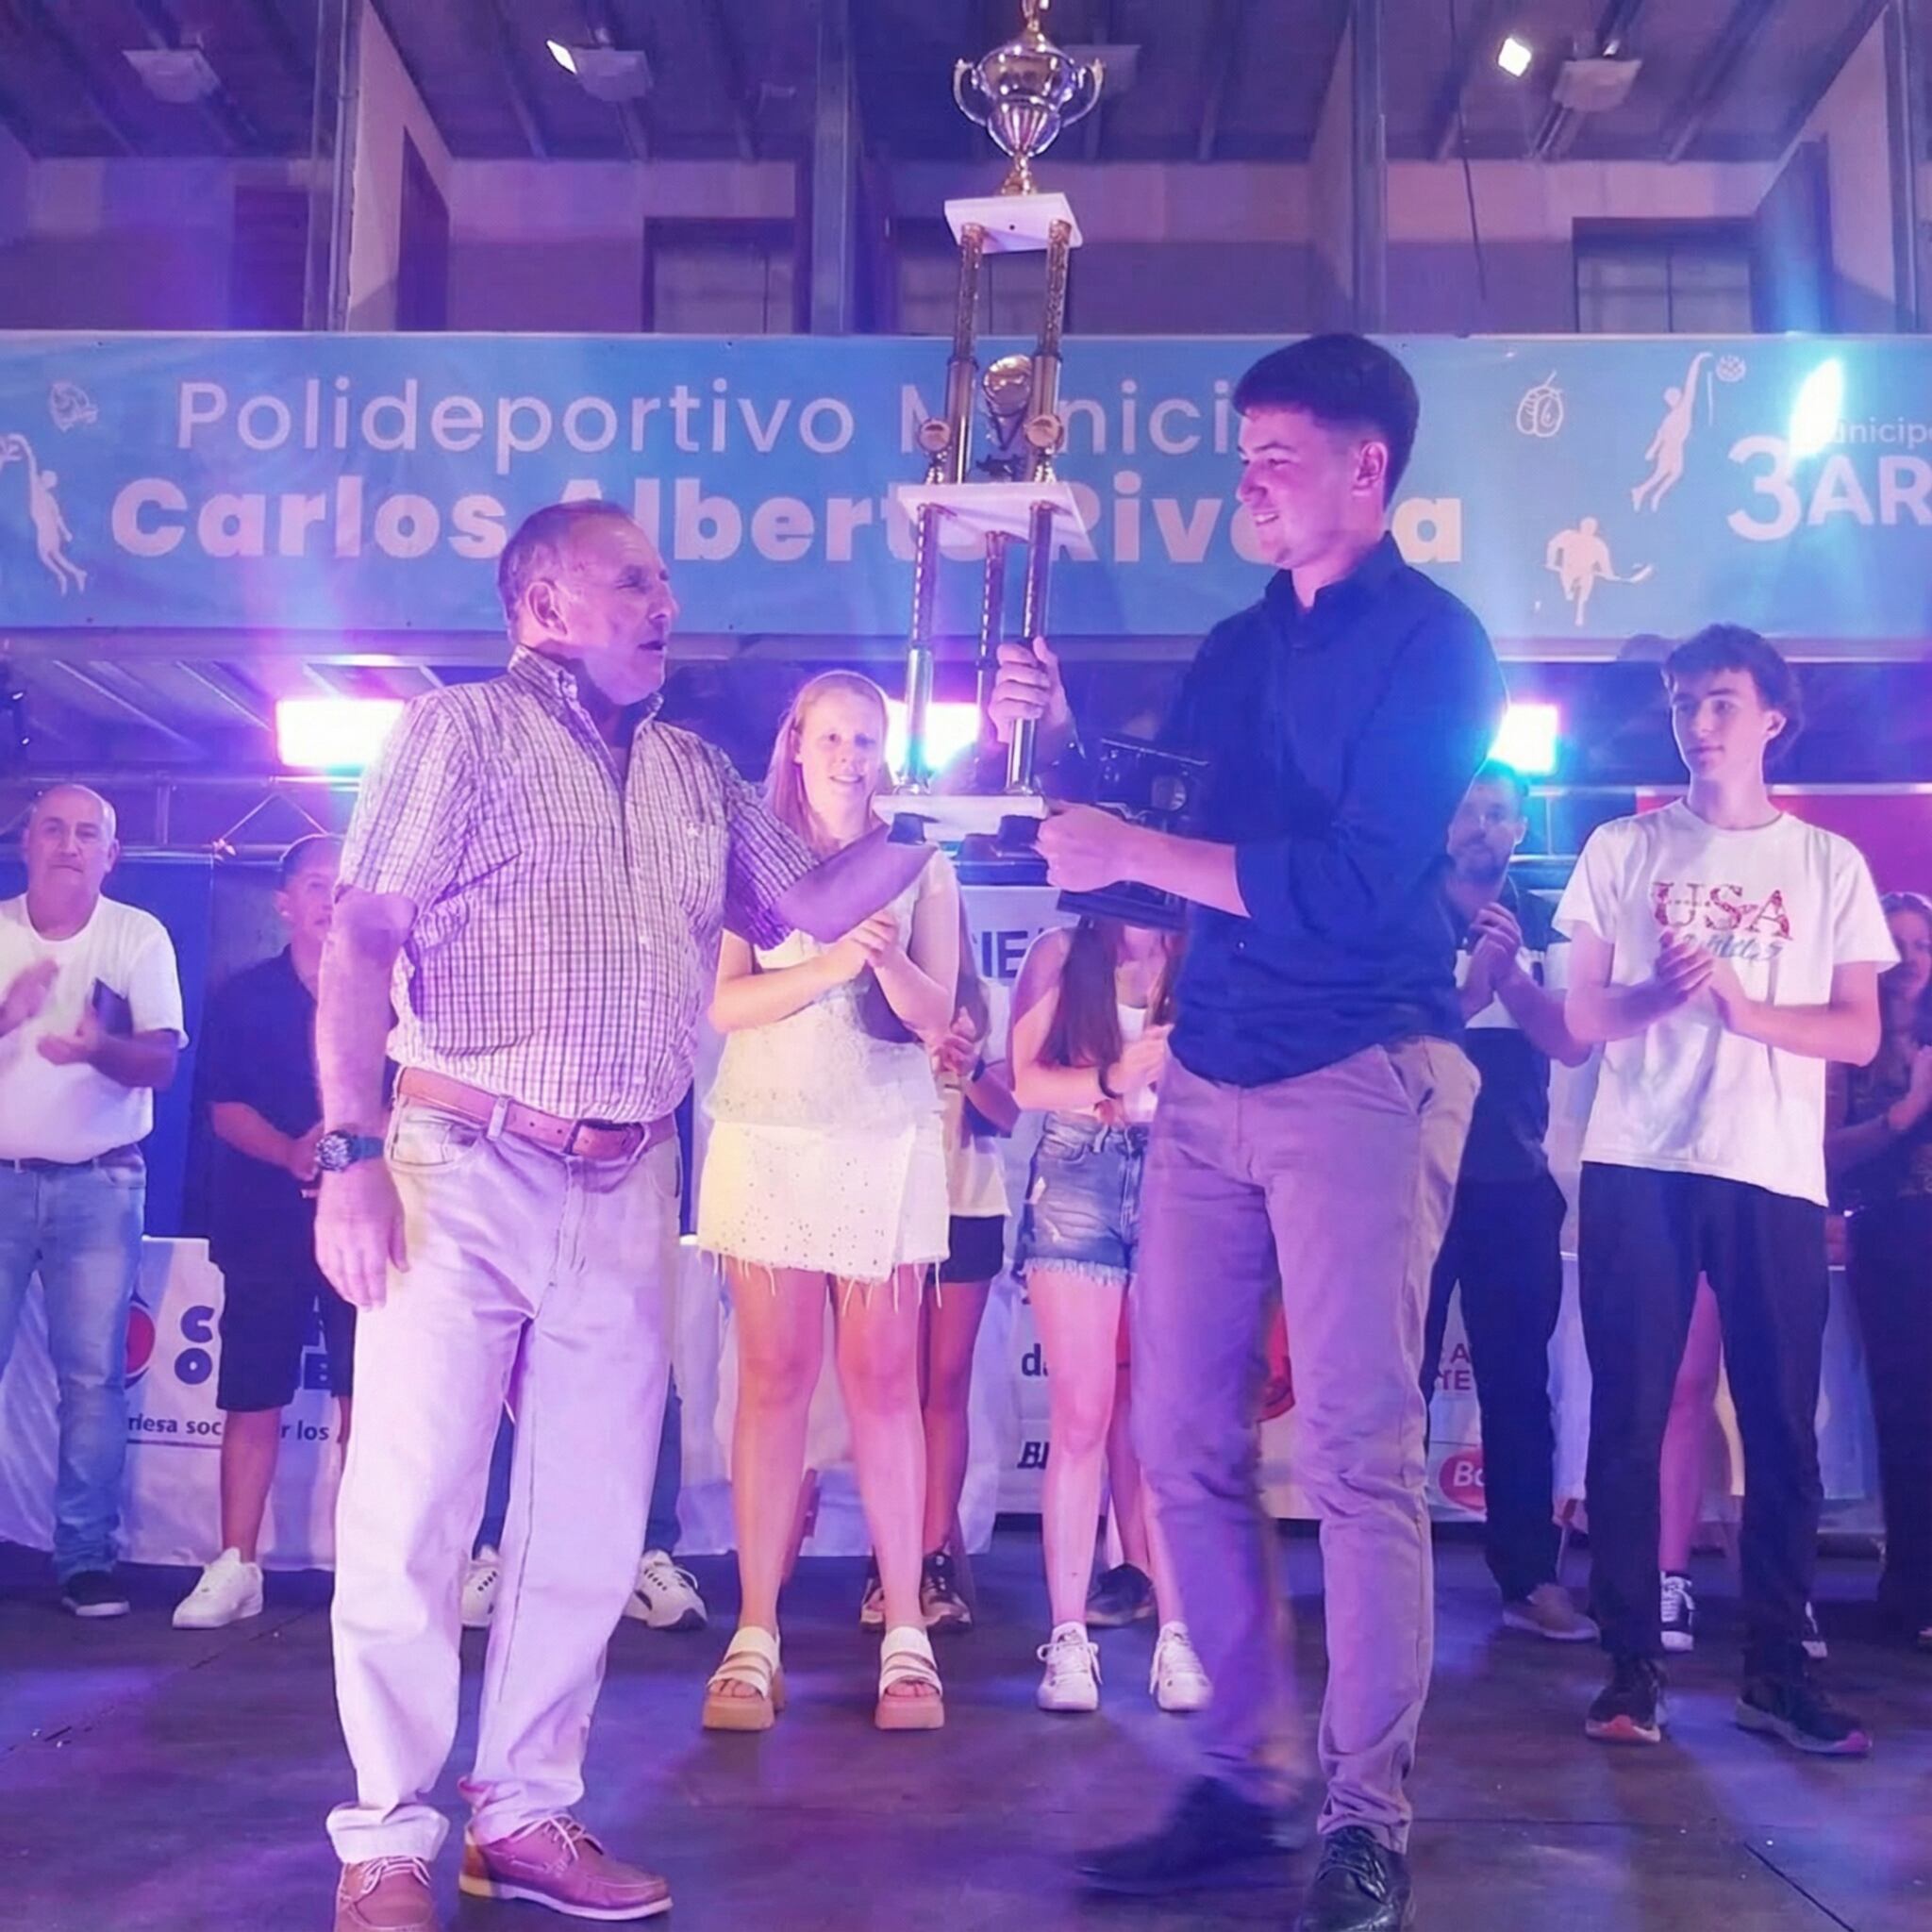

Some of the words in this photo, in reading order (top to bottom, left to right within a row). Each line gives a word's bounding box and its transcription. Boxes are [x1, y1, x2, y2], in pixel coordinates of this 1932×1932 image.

[177, 376, 855, 474] Polideportivo
[111, 475, 508, 558] Carlos
[1653, 881, 1794, 941] USA
[297, 1420, 330, 1441] los
